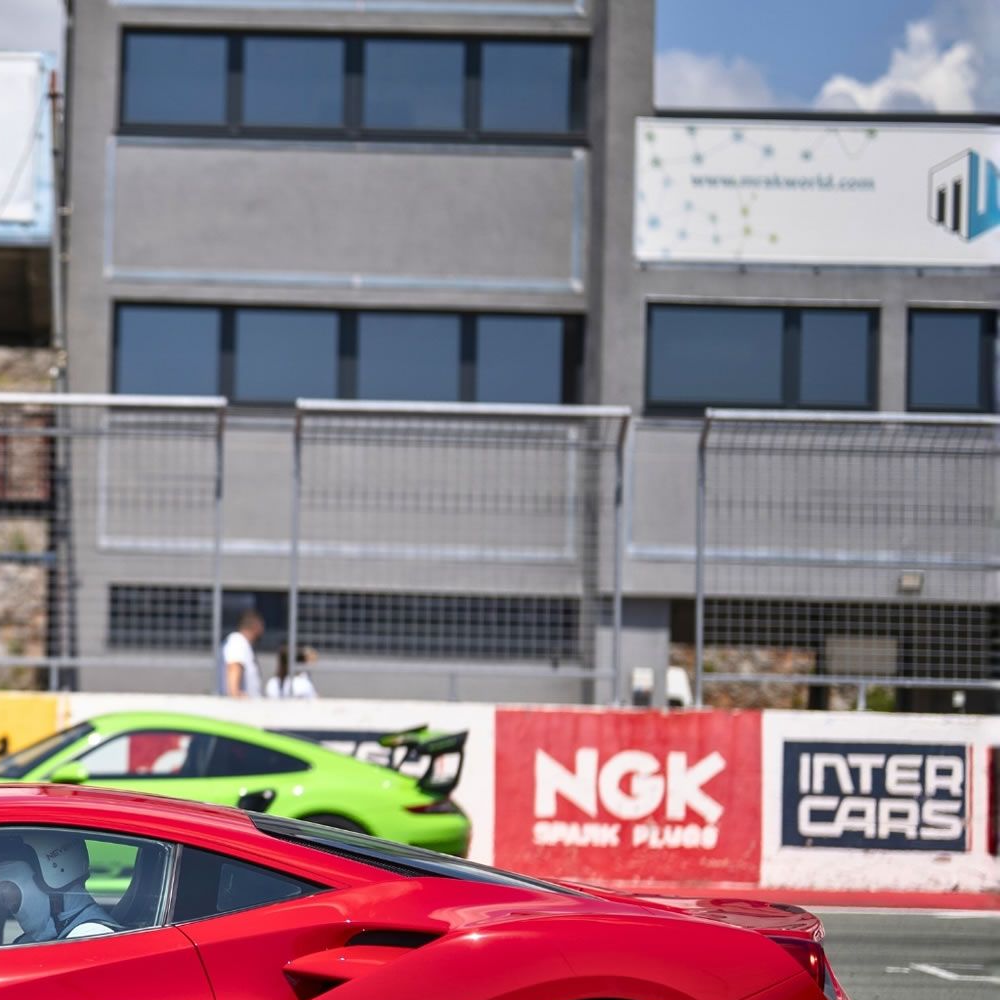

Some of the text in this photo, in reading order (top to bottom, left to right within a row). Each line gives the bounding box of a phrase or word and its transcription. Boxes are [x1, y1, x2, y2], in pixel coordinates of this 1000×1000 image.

[533, 747, 727, 821] NGK
[799, 752, 965, 797] INTER
[533, 820, 720, 849] SPARK PLUGS
[797, 795, 963, 840] CARS
